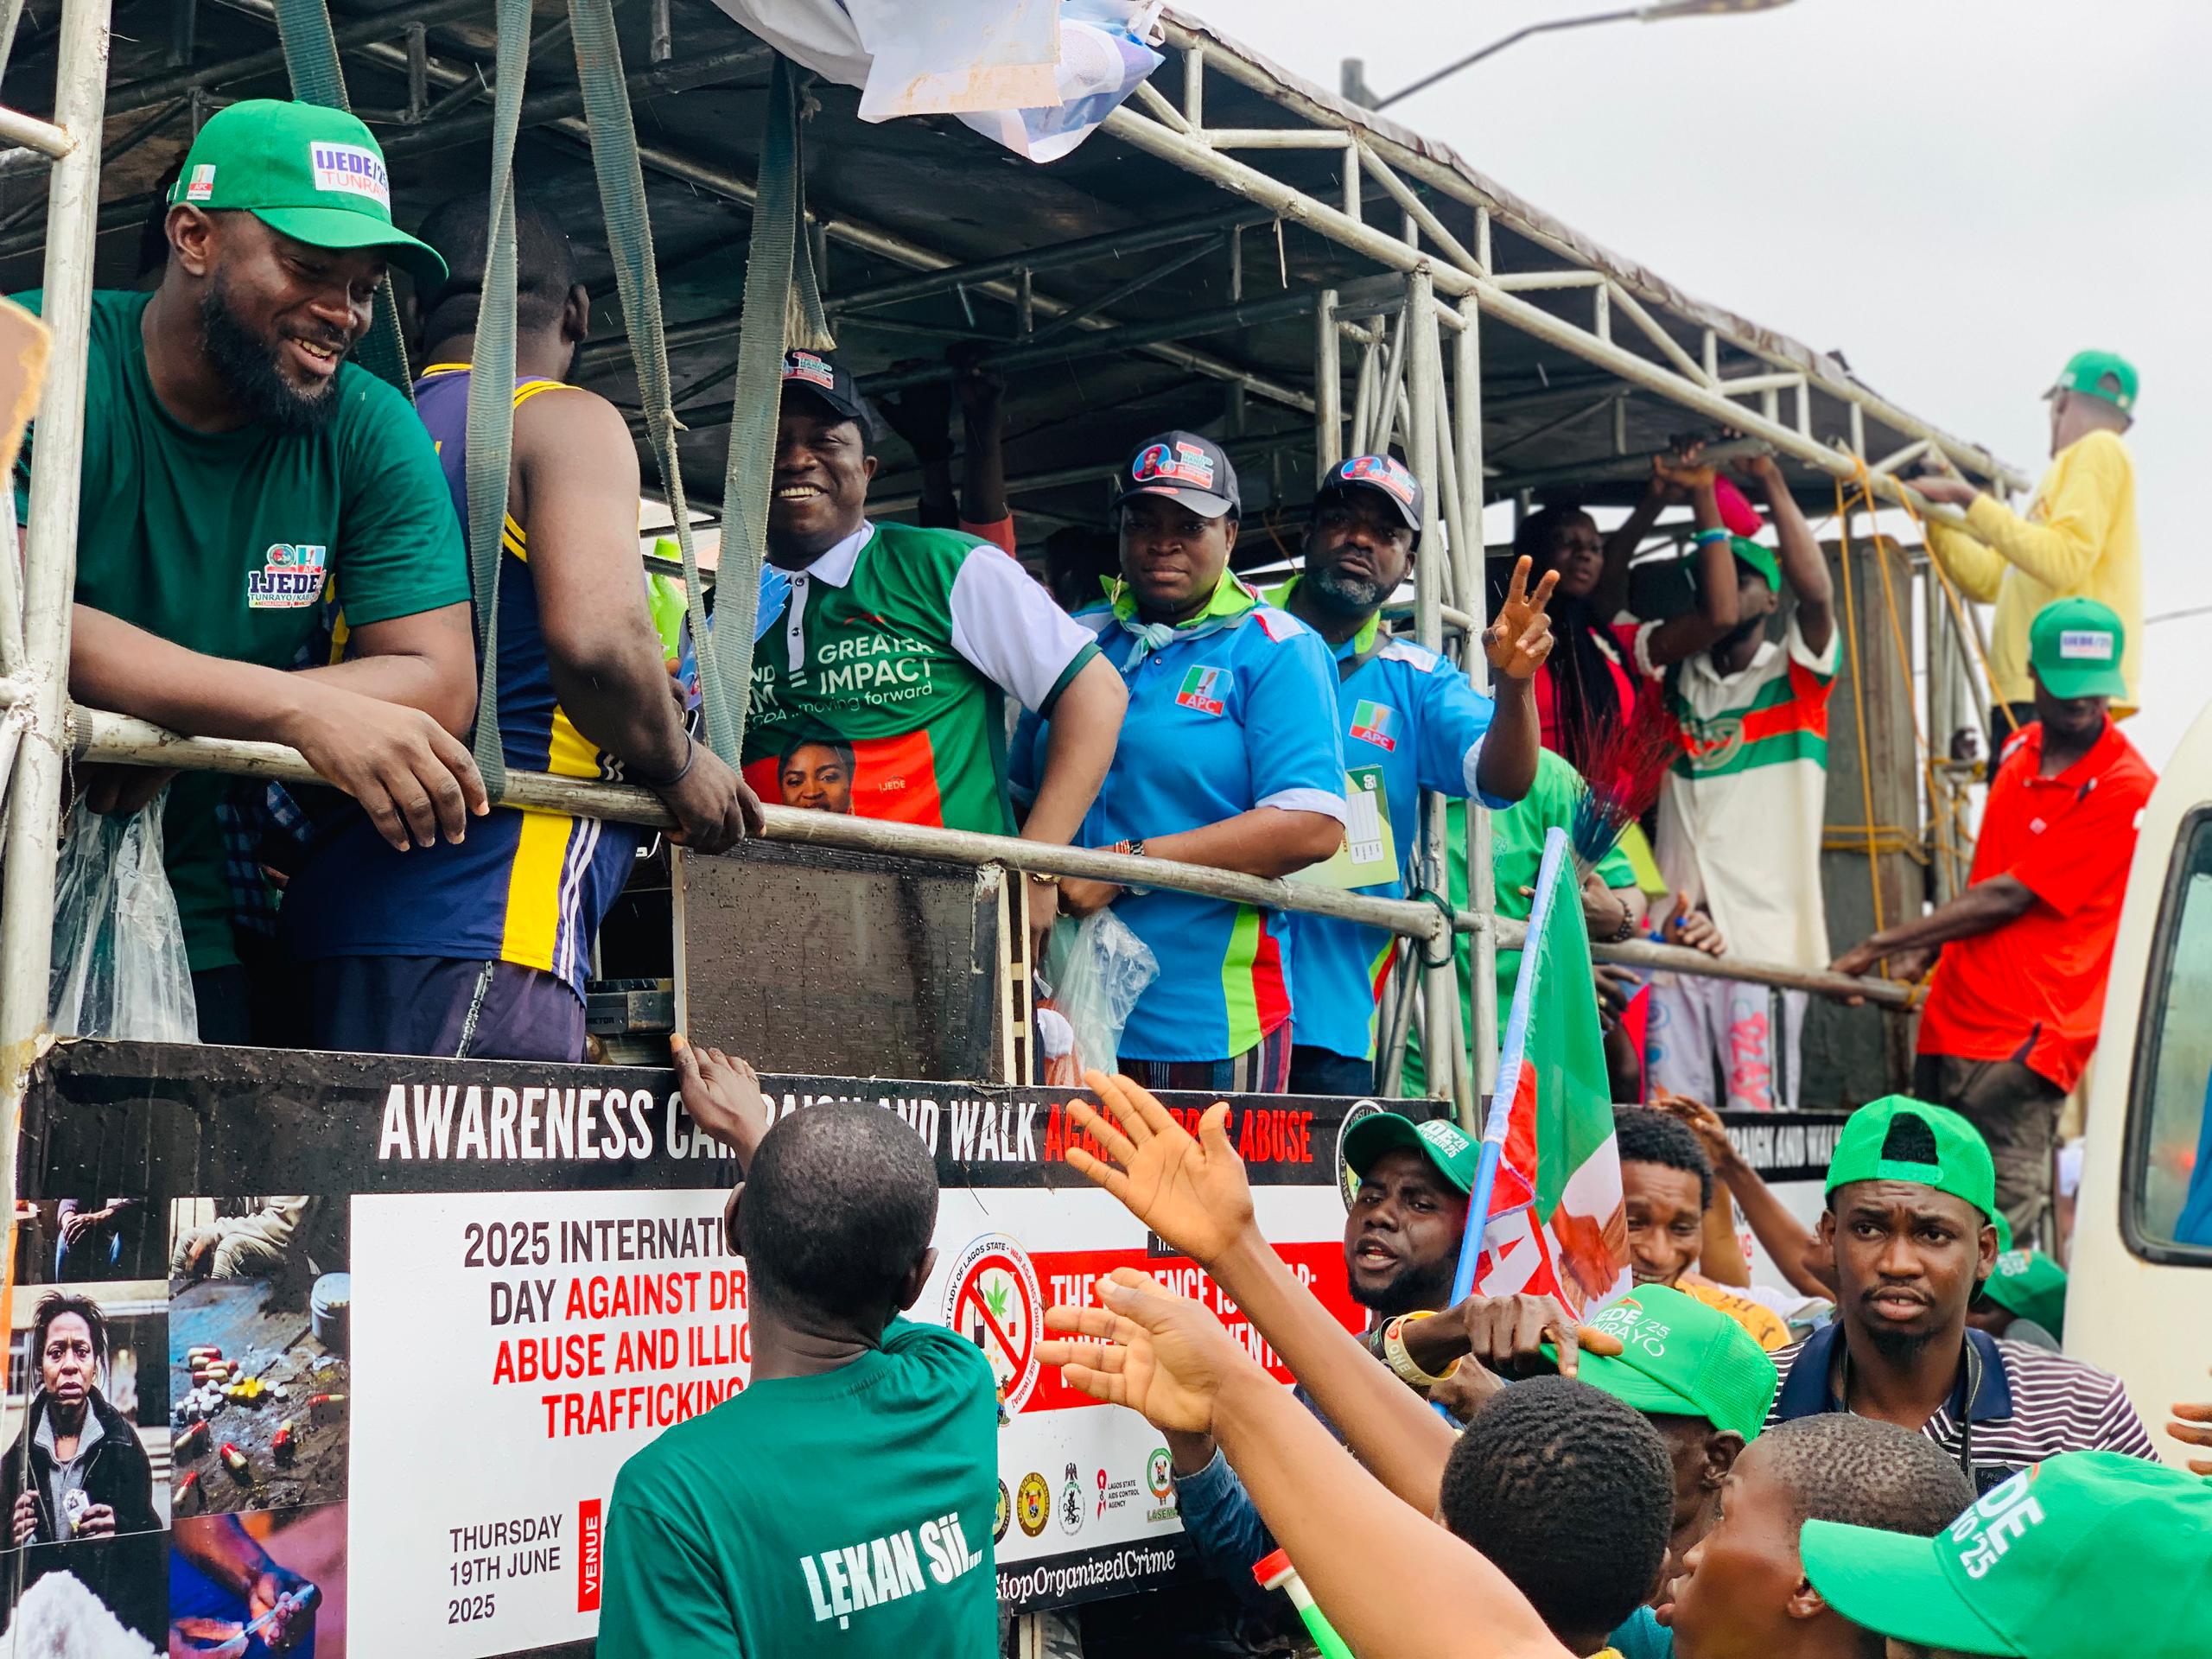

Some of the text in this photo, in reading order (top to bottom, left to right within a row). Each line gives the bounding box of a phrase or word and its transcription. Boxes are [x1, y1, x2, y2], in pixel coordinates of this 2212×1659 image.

[250, 573, 320, 594] IJEDE
[820, 658, 938, 696] IMPACT
[864, 680, 932, 705] forward
[1186, 694, 1217, 713] APC
[1362, 728, 1389, 748] APC
[878, 779, 906, 792] IJEDE
[378, 1084, 653, 1160] AWARENESS
[951, 1100, 1037, 1161] WALK
[1239, 1109, 1313, 1163] ABUSE
[1445, 1146, 1460, 1159] 25
[464, 1217, 750, 1268] 2025 INTERNATI
[956, 1268, 964, 1282] OF
[963, 1244, 985, 1269] LAGOS
[986, 1242, 1006, 1252] STATE
[1009, 1247, 1023, 1265] WAR
[491, 1269, 747, 1326] DAY AGAINST DR
[1050, 1274, 1095, 1309] THE
[493, 1323, 751, 1386] ABUSE AND ILLIC
[1389, 1344, 1411, 1373] ONE
[1108, 1479, 1136, 1491] LAGOS STATE
[1108, 1489, 1140, 1500] AIDS CONTROL
[1108, 1500, 1126, 1509] AGENCY
[449, 1514, 599, 1595] THURSDAY VENUE
[449, 1546, 562, 1586] 19TH JUNE
[448, 1593, 495, 1624] 2025
